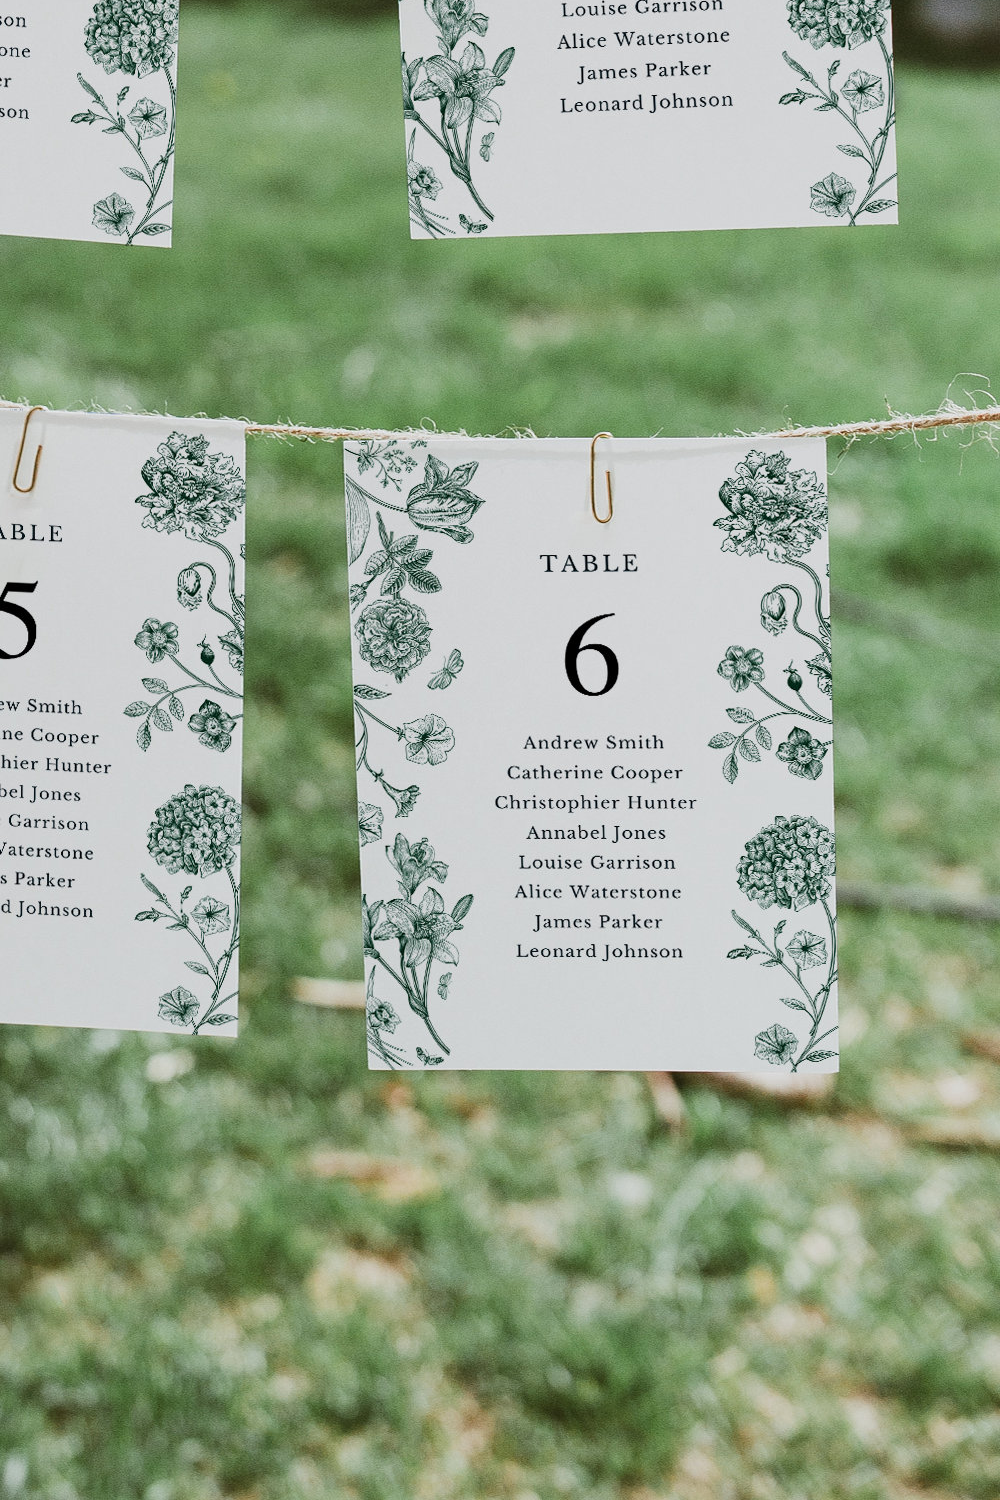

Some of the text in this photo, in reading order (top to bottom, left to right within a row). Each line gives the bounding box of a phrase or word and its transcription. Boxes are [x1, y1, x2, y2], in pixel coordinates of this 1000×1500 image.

[561, 0, 627, 18] Louise
[556, 30, 730, 50] Alice Waterstone
[576, 60, 712, 86] James Parker
[559, 92, 734, 114] Leonard Johnson
[539, 553, 639, 573] TABLE
[564, 612, 620, 697] 6
[26, 698, 83, 715] Smith
[30, 727, 100, 748] Cooper
[522, 734, 665, 750] Andrew Smith
[45, 757, 112, 774] Hunter
[506, 764, 684, 784] Catherine Cooper
[29, 785, 81, 804] Jones
[494, 794, 698, 814] Christophier Hunter
[8, 813, 89, 832] Garrison
[525, 824, 667, 844] Annabel Jones
[518, 854, 677, 870] Louise Garrison
[14, 871, 76, 889] Parker
[514, 883, 682, 900] Alice Waterstone
[15, 900, 94, 918] Johnson
[532, 913, 663, 933] James Parker
[515, 943, 684, 962] Leonard Johnson
